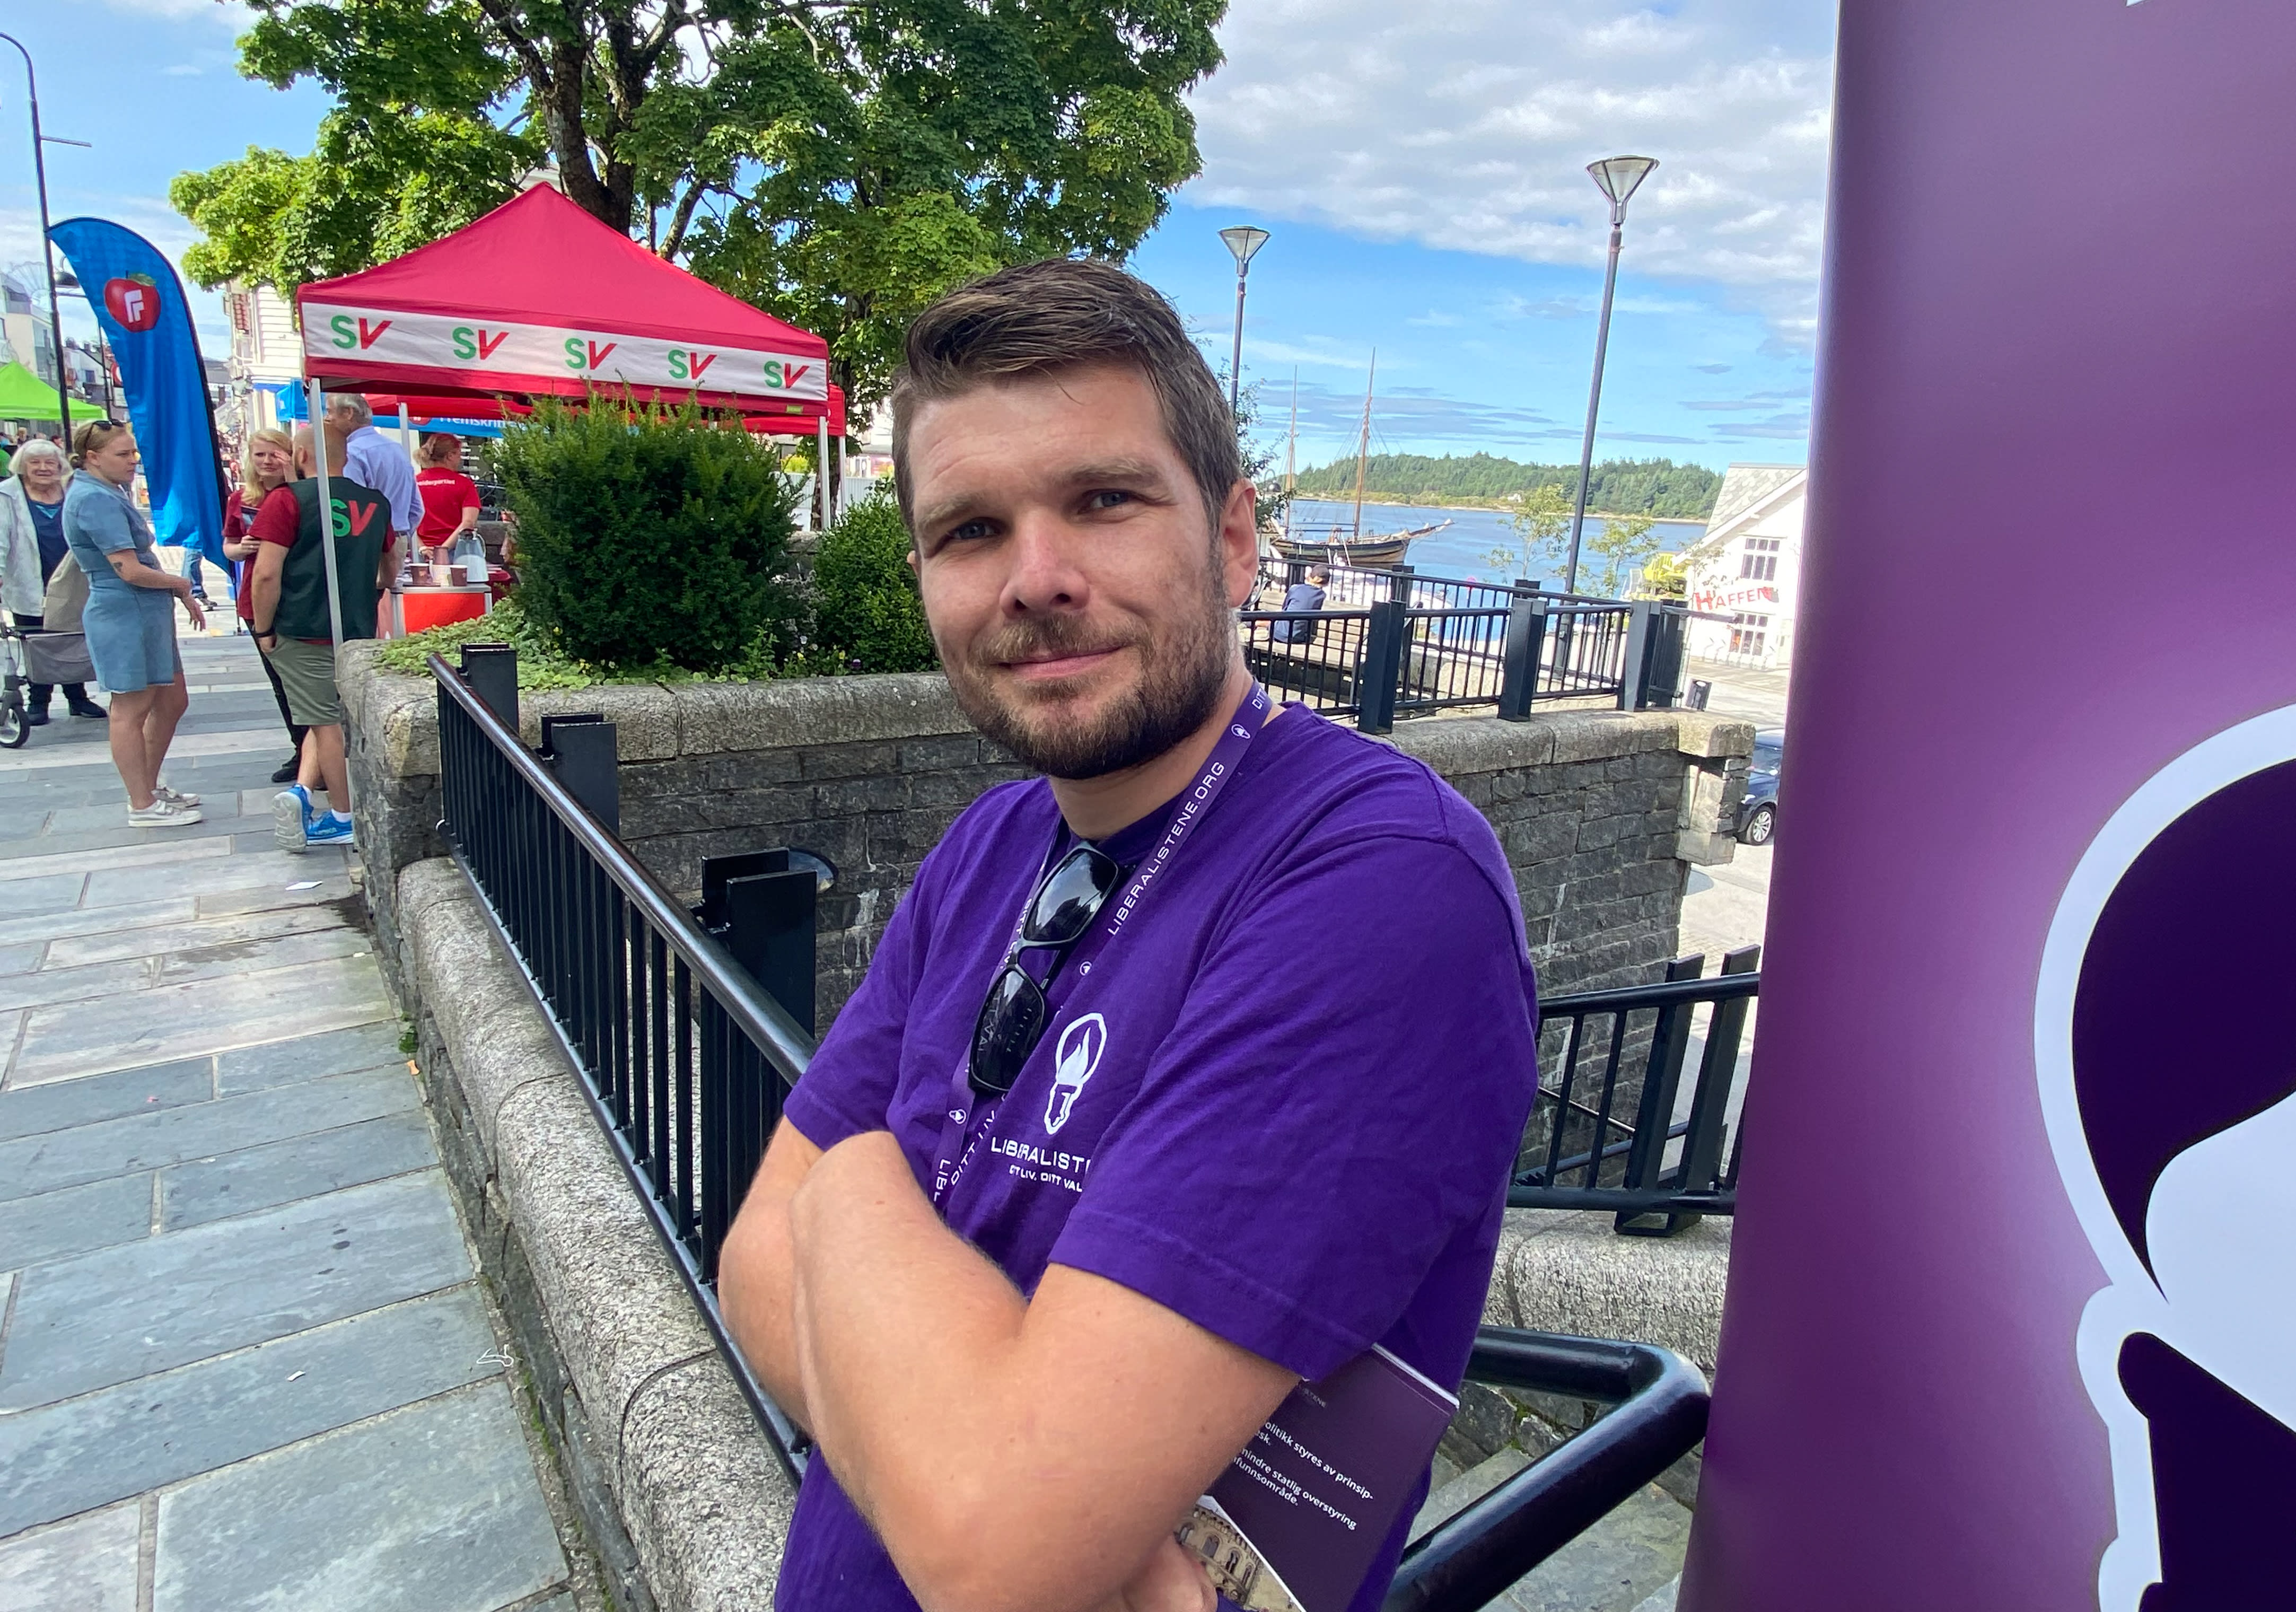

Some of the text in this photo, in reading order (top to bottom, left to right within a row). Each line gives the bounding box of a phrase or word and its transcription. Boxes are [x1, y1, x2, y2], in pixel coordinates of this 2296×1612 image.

[330, 315, 392, 350] SV
[452, 327, 510, 361] SV
[564, 338, 617, 370] SV
[668, 349, 717, 380] SV
[764, 361, 810, 389] SV
[330, 498, 378, 537] SV
[1108, 762, 1225, 936] LIBERALISTENE.ORG
[1293, 1442, 1322, 1468] styres
[1323, 1464, 1336, 1476] av
[1335, 1472, 1373, 1500] prinsip-
[1272, 1470, 1302, 1496] statlig
[1302, 1491, 1357, 1531] overstyring
